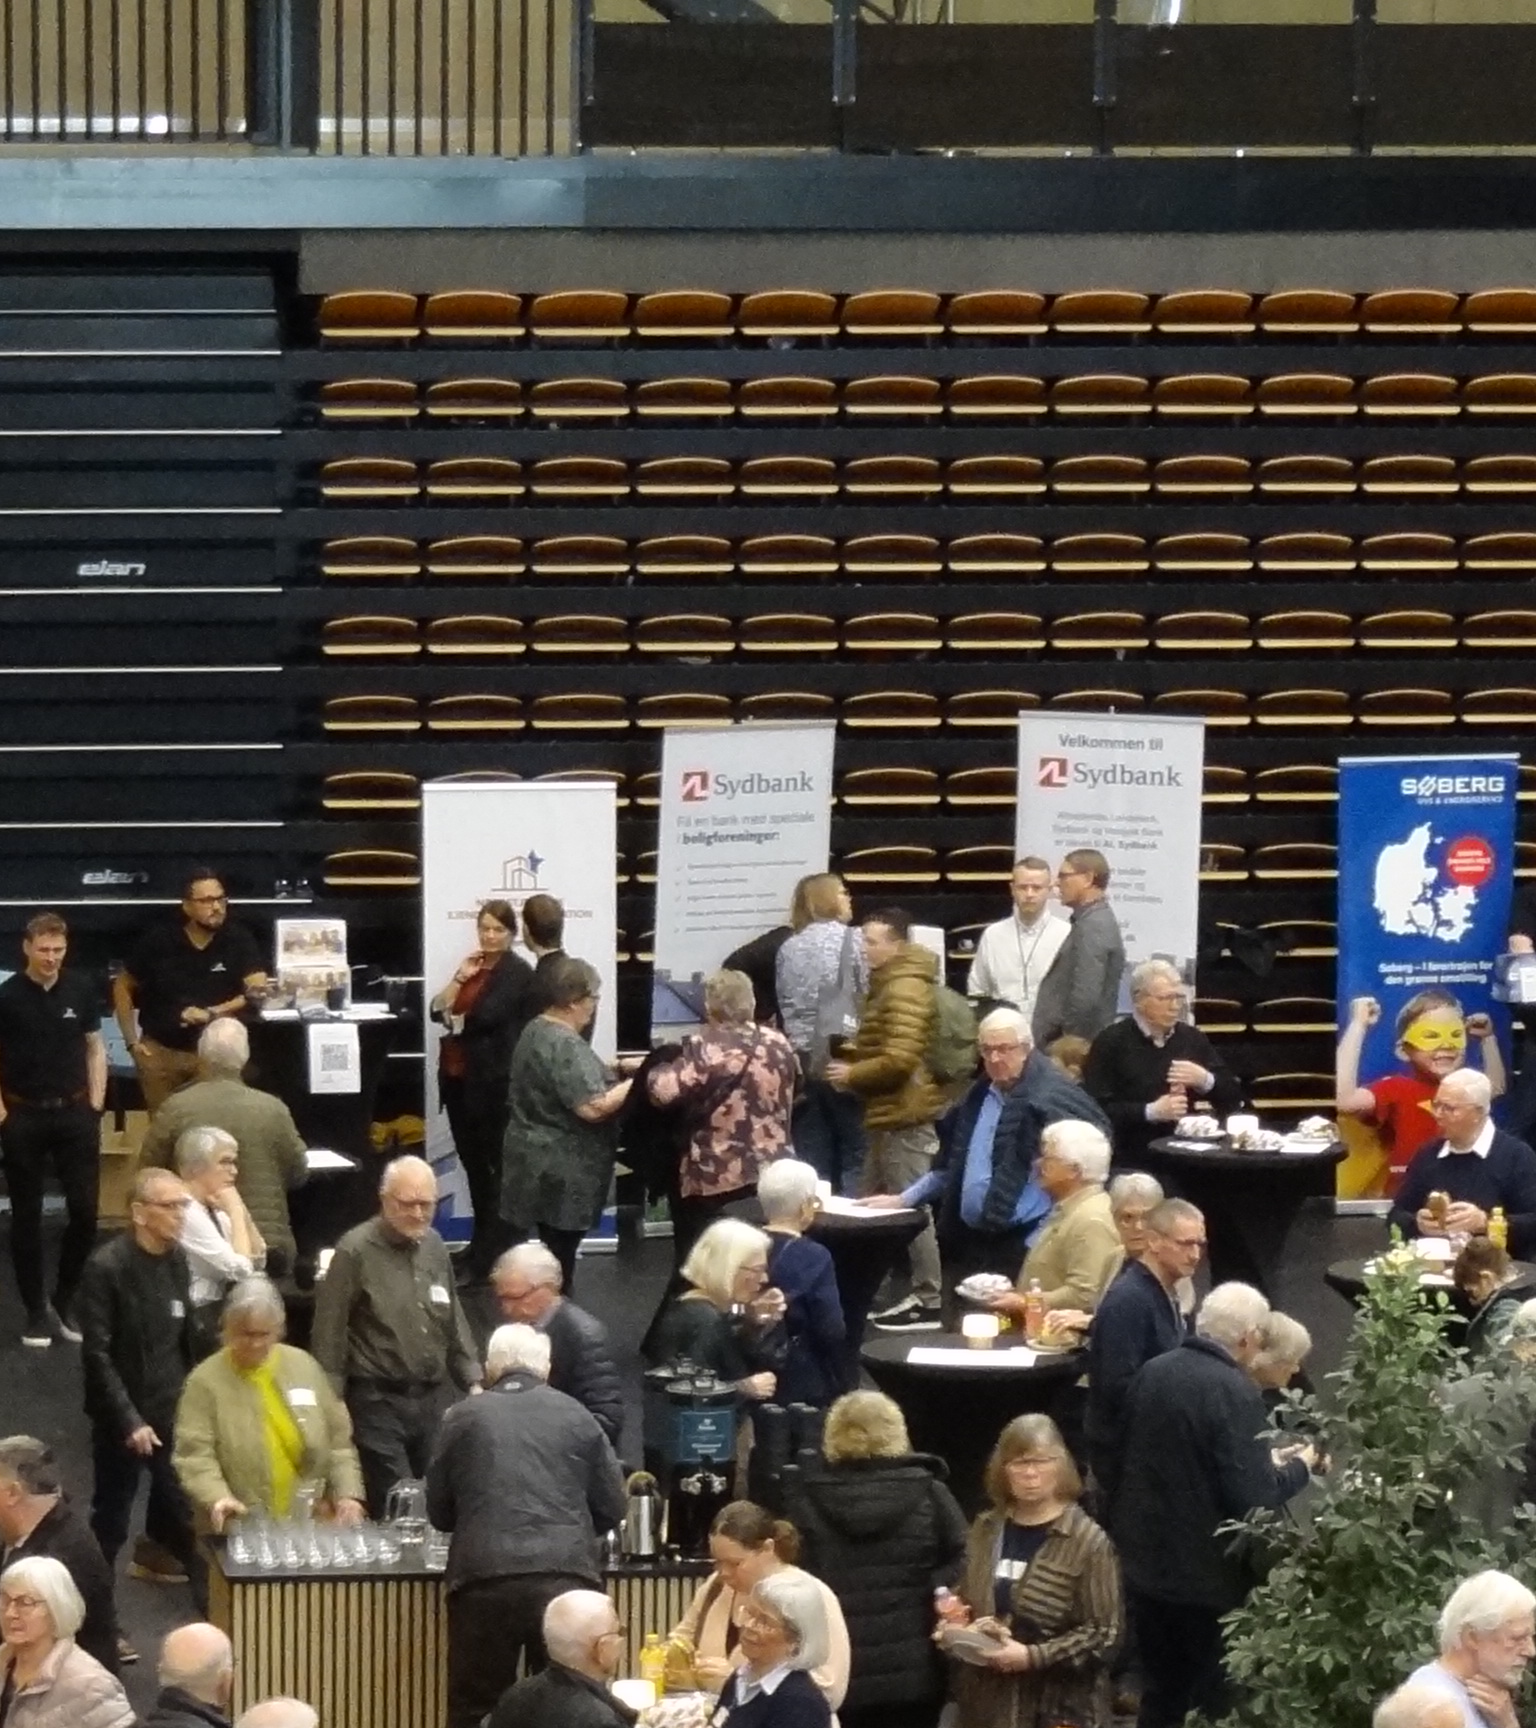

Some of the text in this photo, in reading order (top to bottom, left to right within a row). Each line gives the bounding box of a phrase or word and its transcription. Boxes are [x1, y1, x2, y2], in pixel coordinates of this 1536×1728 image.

[1059, 734, 1164, 751] Velkommen til
[714, 771, 814, 800] Sydbank
[1073, 762, 1183, 788] Sydbank
[1401, 776, 1505, 796] SØBERG
